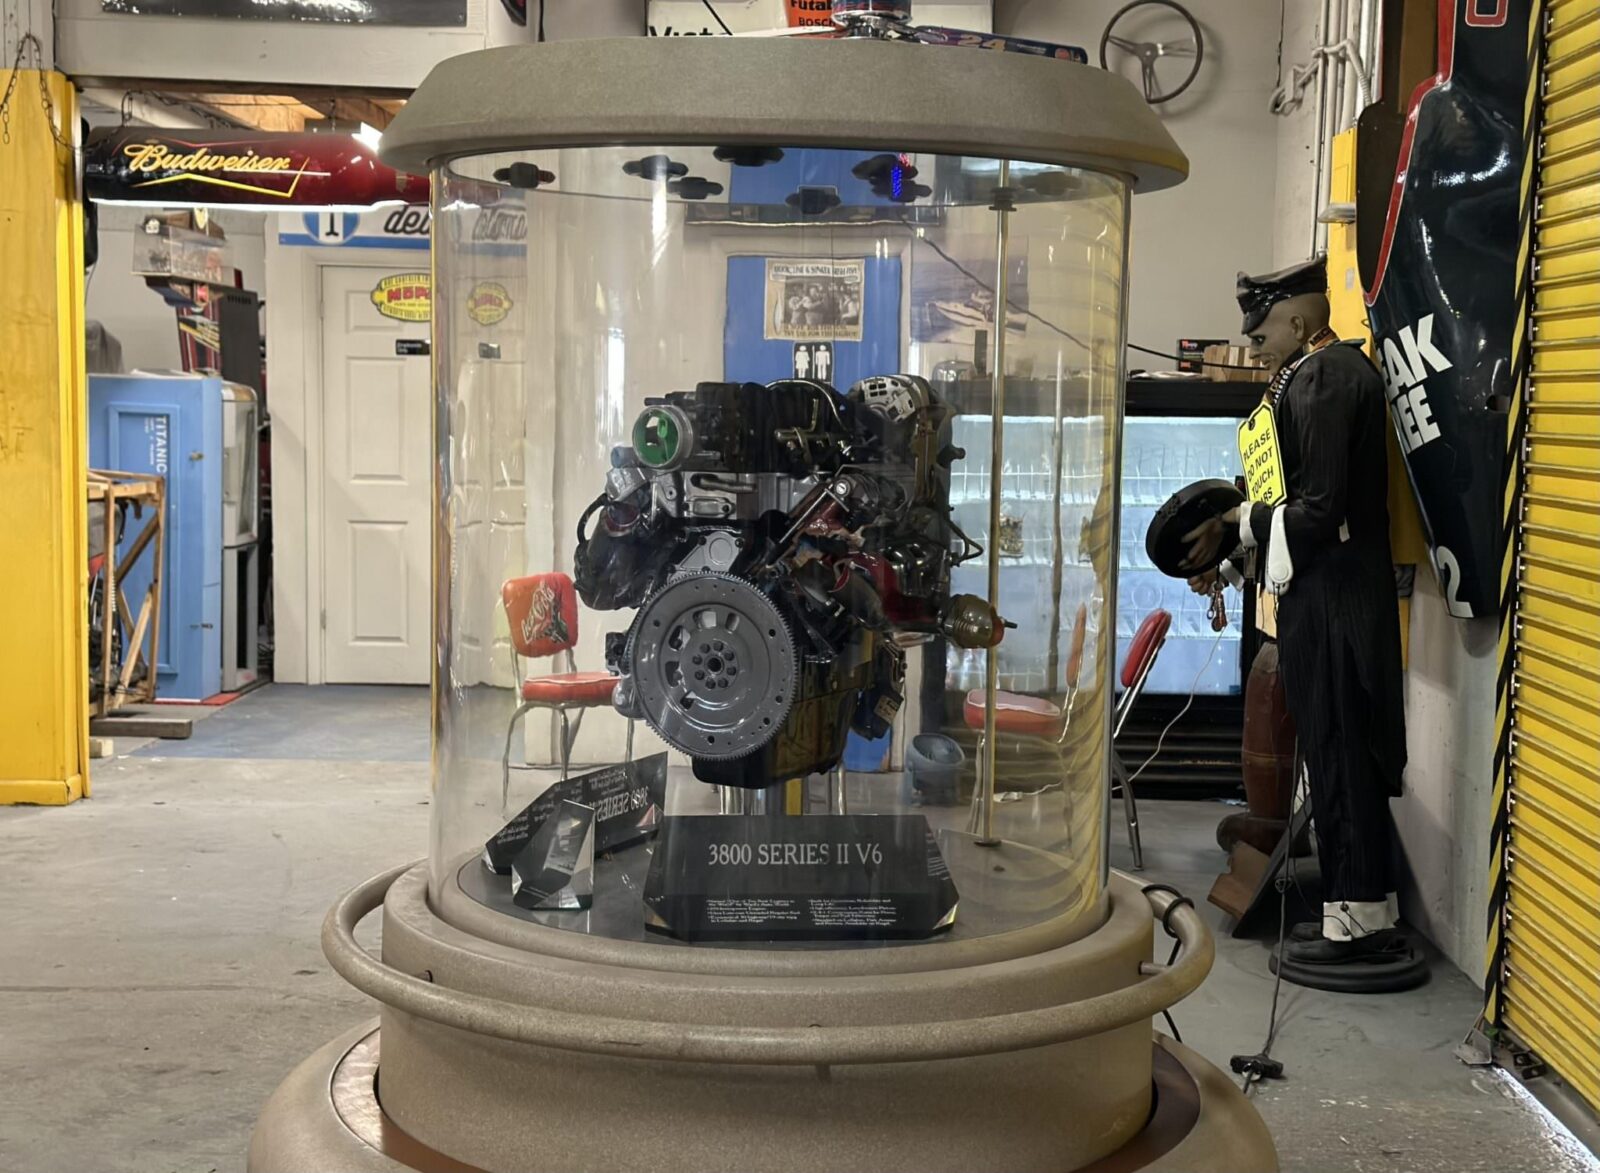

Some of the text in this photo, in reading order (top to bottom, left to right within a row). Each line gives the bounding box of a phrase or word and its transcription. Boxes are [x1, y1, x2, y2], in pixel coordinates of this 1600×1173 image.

[123, 143, 291, 172] Budweiser
[156, 416, 168, 473] TITANIC
[1242, 428, 1271, 465] PLEASE
[1247, 446, 1273, 483] DO NOT
[1251, 465, 1274, 499] TOUCH
[1259, 486, 1273, 504] ARS
[707, 843, 752, 866] 3800
[757, 843, 830, 866] SERIES
[855, 843, 883, 865] V6
